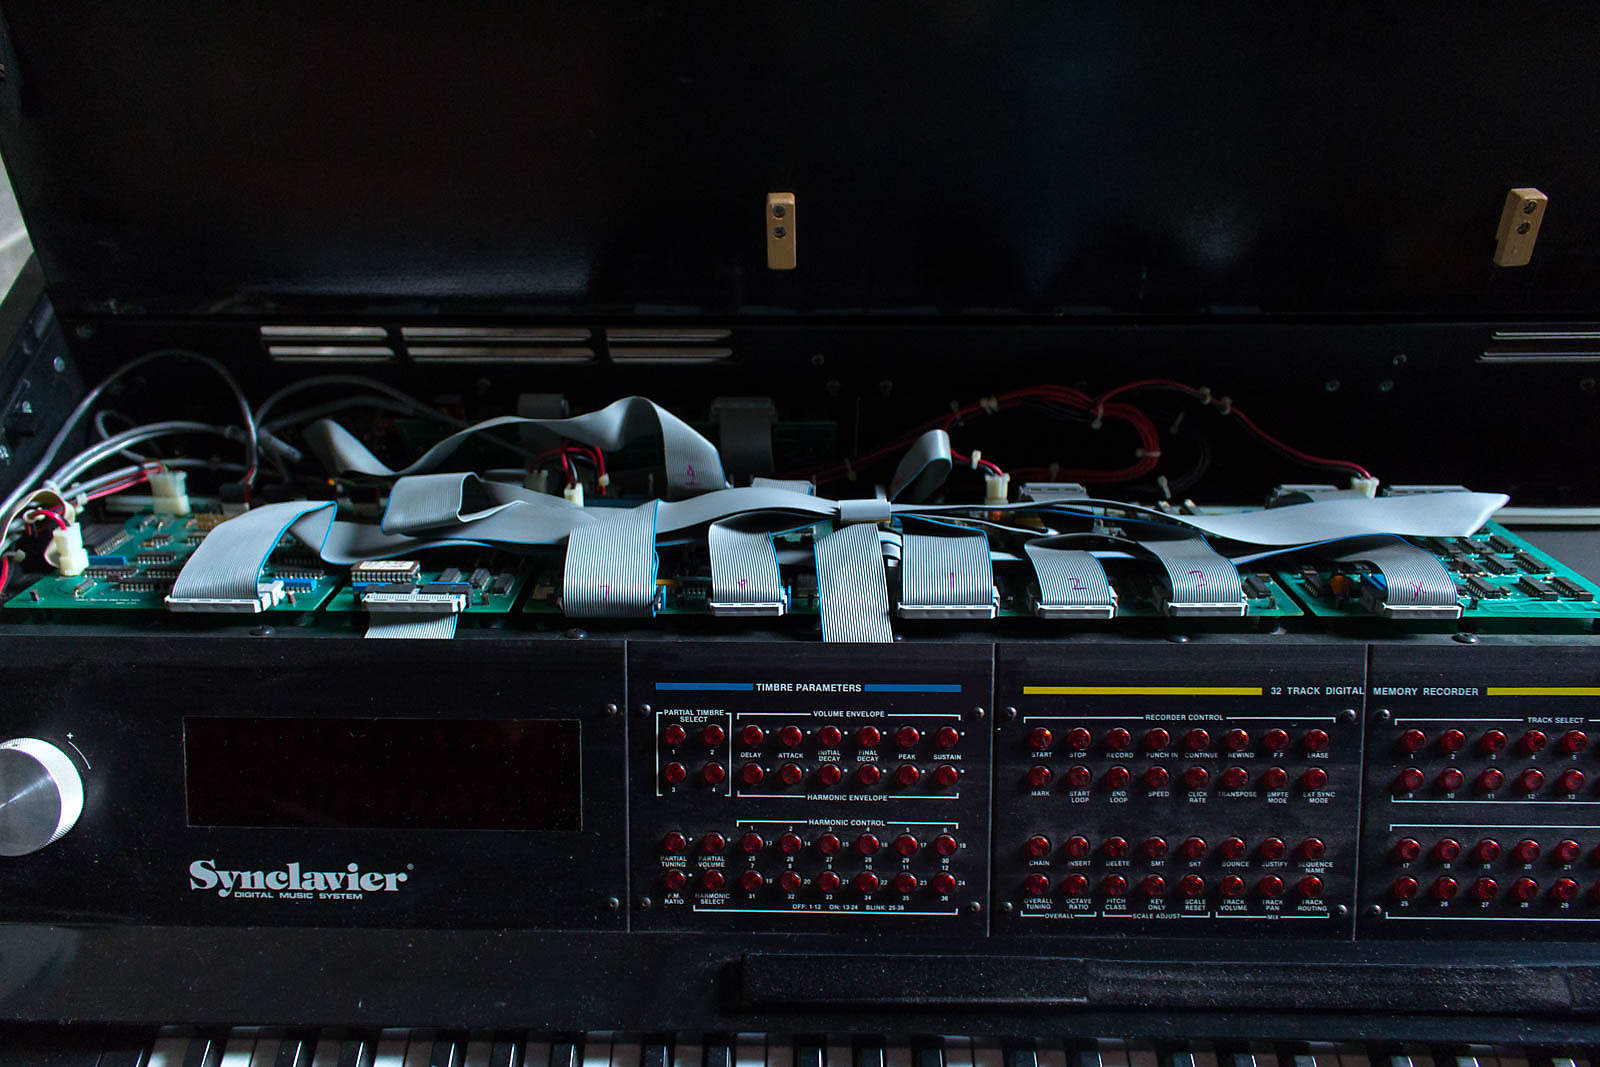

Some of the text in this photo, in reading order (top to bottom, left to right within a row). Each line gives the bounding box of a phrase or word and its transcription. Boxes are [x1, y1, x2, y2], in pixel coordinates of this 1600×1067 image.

[756, 683, 862, 692] TIMBRE PARAMETERS
[1271, 687, 1479, 696] 32 TRACK DIGITAL MEMORY RECORDER
[846, 710, 885, 718] ENVELOPE
[1555, 717, 1585, 725] SELECT
[808, 818, 886, 827] HARMONIC CONTROL
[189, 858, 409, 898] Synclavier
[234, 891, 274, 899] DIGITAL
[319, 892, 363, 900] SYSTEM
